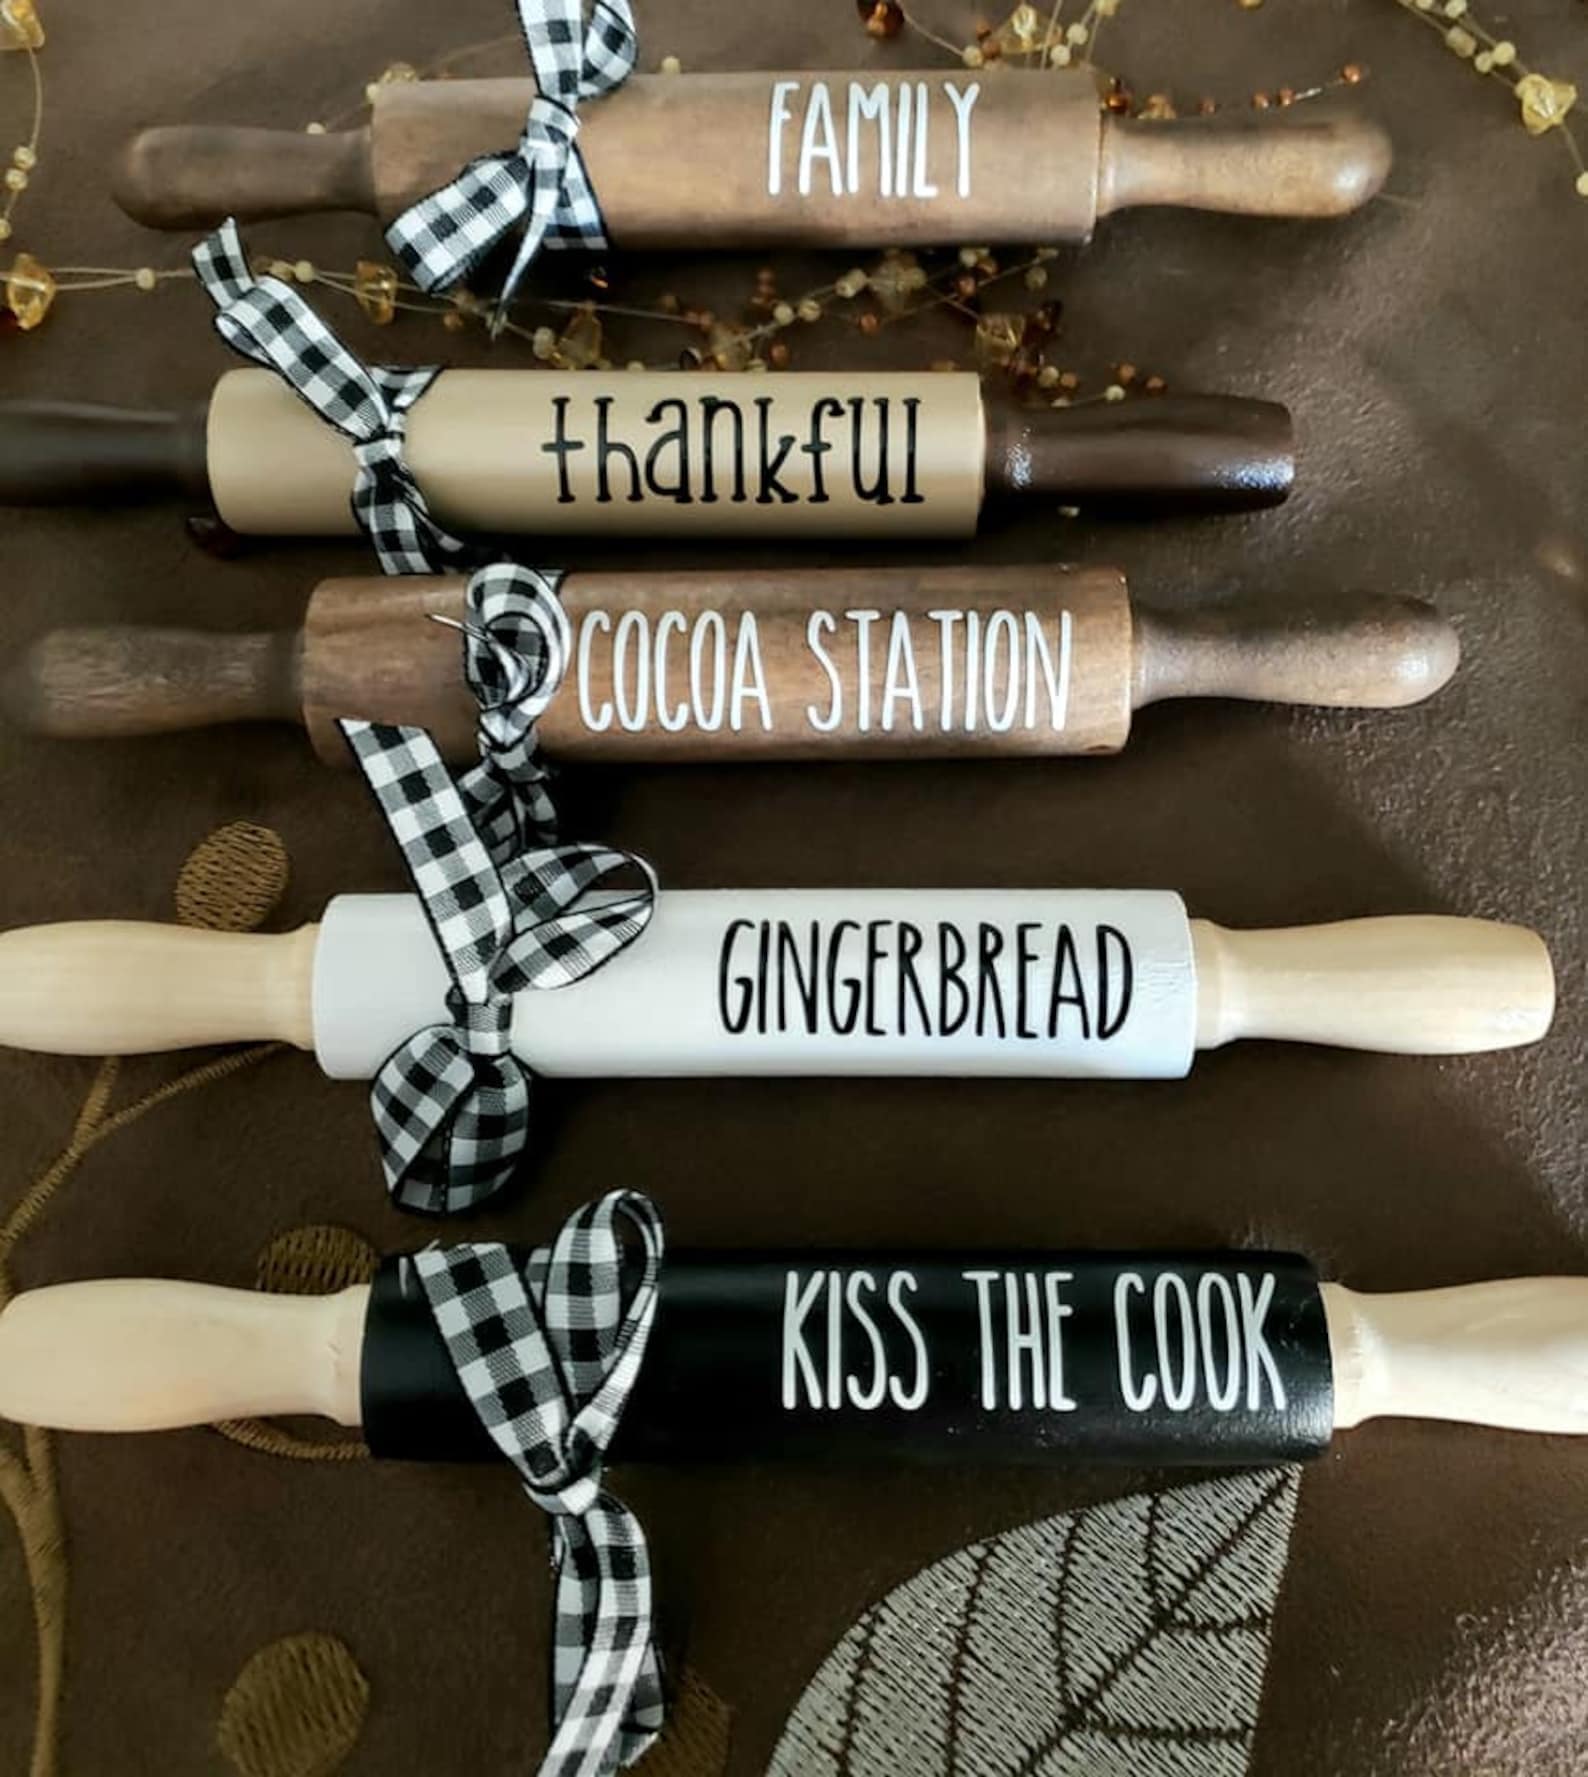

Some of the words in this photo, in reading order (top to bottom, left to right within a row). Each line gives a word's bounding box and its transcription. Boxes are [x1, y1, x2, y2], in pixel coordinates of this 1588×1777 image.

[768, 82, 980, 198] FAMILY
[540, 396, 925, 505] thankful
[578, 610, 773, 732] COCOA
[807, 610, 1073, 732] STATION
[718, 919, 1134, 1040] GINGERBREAD
[782, 1270, 929, 1411] KISS
[962, 1270, 1077, 1412] THE
[1114, 1272, 1289, 1413] COOK
